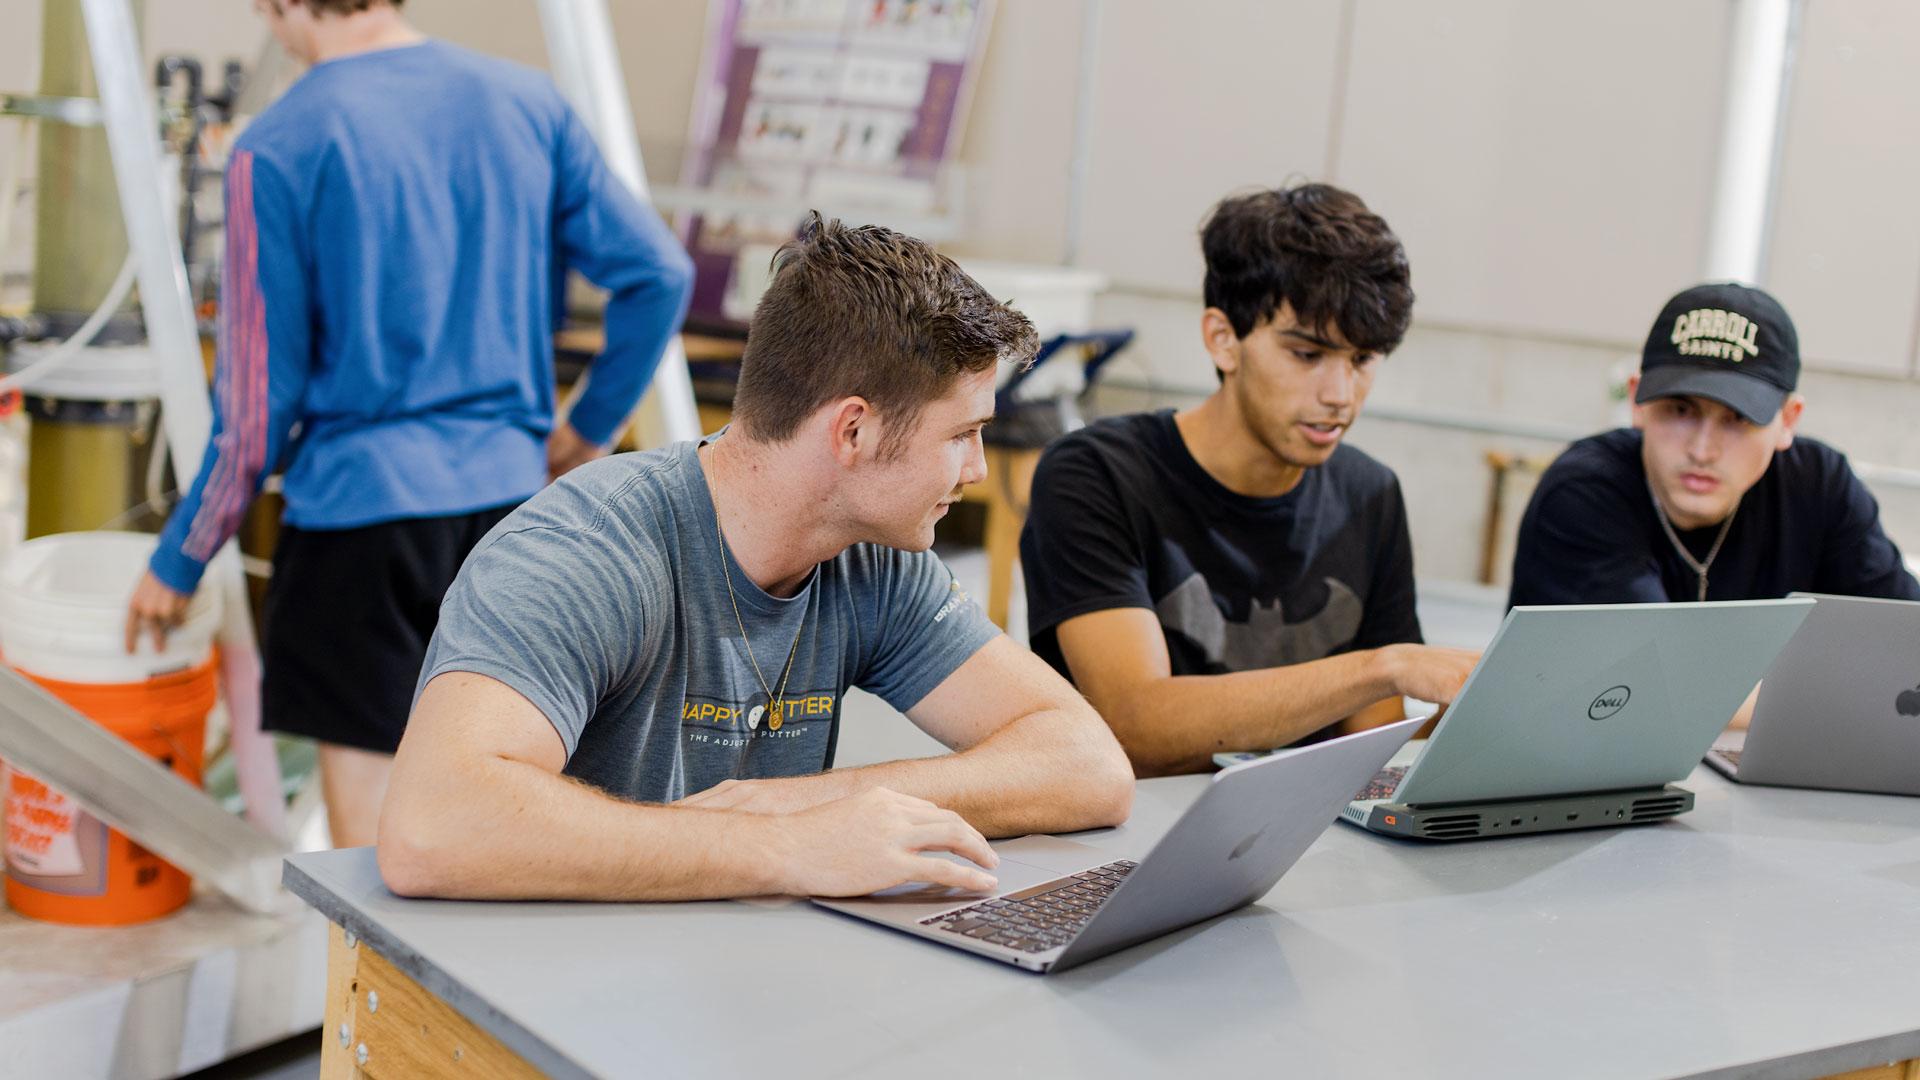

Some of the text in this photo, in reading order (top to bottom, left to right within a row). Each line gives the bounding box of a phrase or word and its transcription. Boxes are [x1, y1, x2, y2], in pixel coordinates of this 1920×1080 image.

[1671, 308, 1759, 357] CARROLL
[1678, 338, 1744, 363] SAINTS
[764, 696, 833, 718] UTTER
[1595, 697, 1622, 708] DELL
[690, 734, 708, 743] THE
